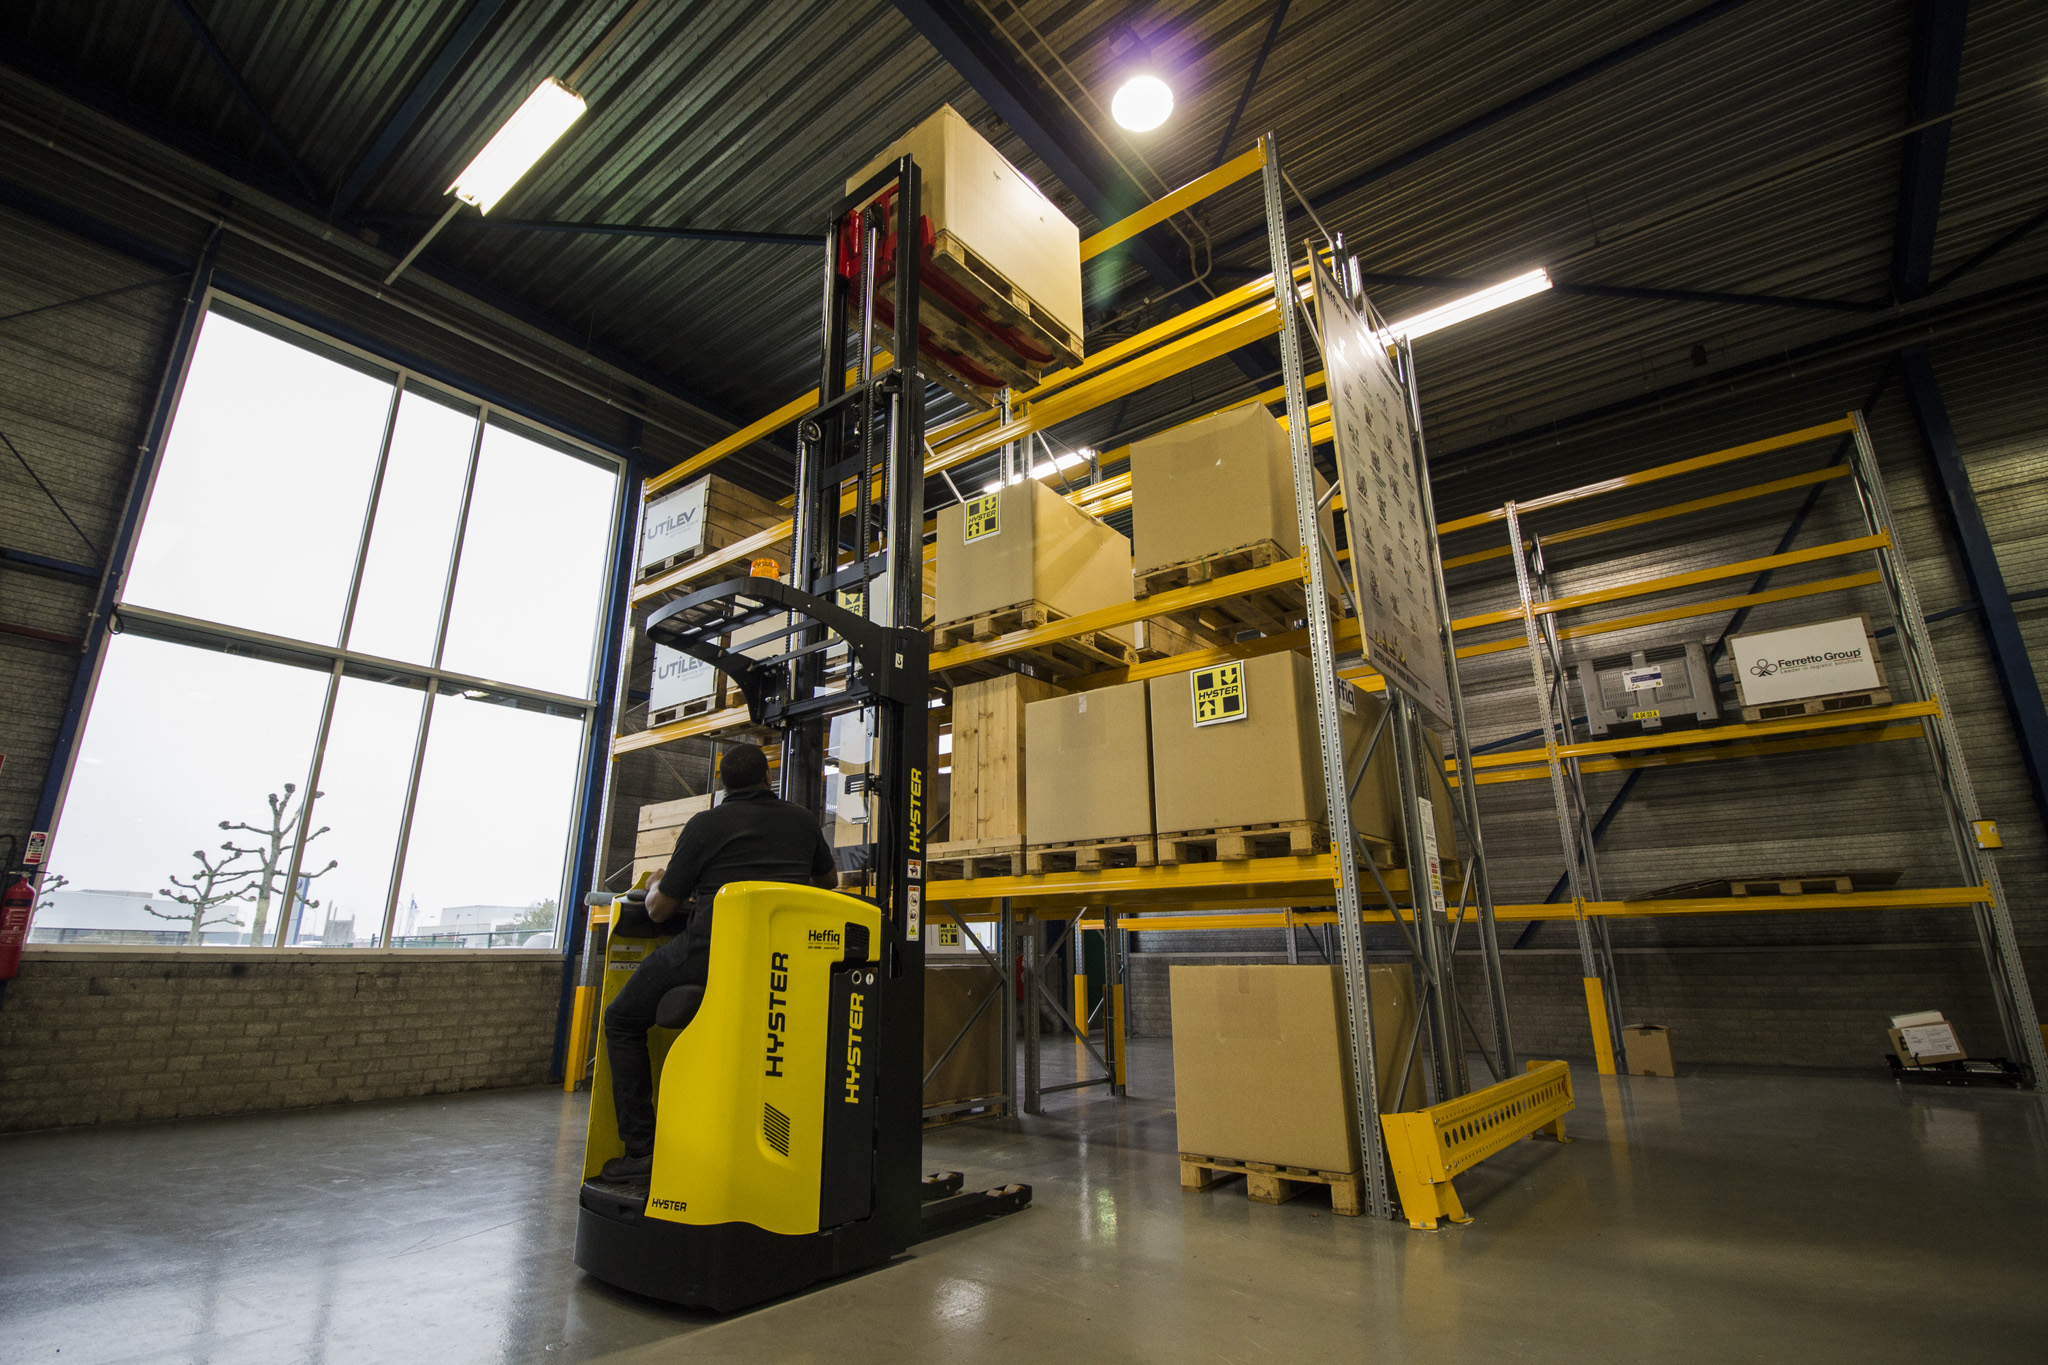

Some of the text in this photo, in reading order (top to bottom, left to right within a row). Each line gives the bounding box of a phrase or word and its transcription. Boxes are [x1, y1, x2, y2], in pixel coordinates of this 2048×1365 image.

[648, 507, 697, 539] UTILEV
[968, 510, 997, 524] HYSTER
[1778, 649, 1861, 668] Ferretto Group
[1810, 662, 1833, 670] logistic
[1835, 658, 1863, 666] solutions
[1198, 685, 1239, 700] HYSTER
[909, 768, 922, 853] HYSTER
[808, 930, 840, 945] Heffiq
[765, 952, 789, 1078] HYSTER
[845, 992, 864, 1104] HYSTER
[652, 1198, 687, 1212] HYSTER
